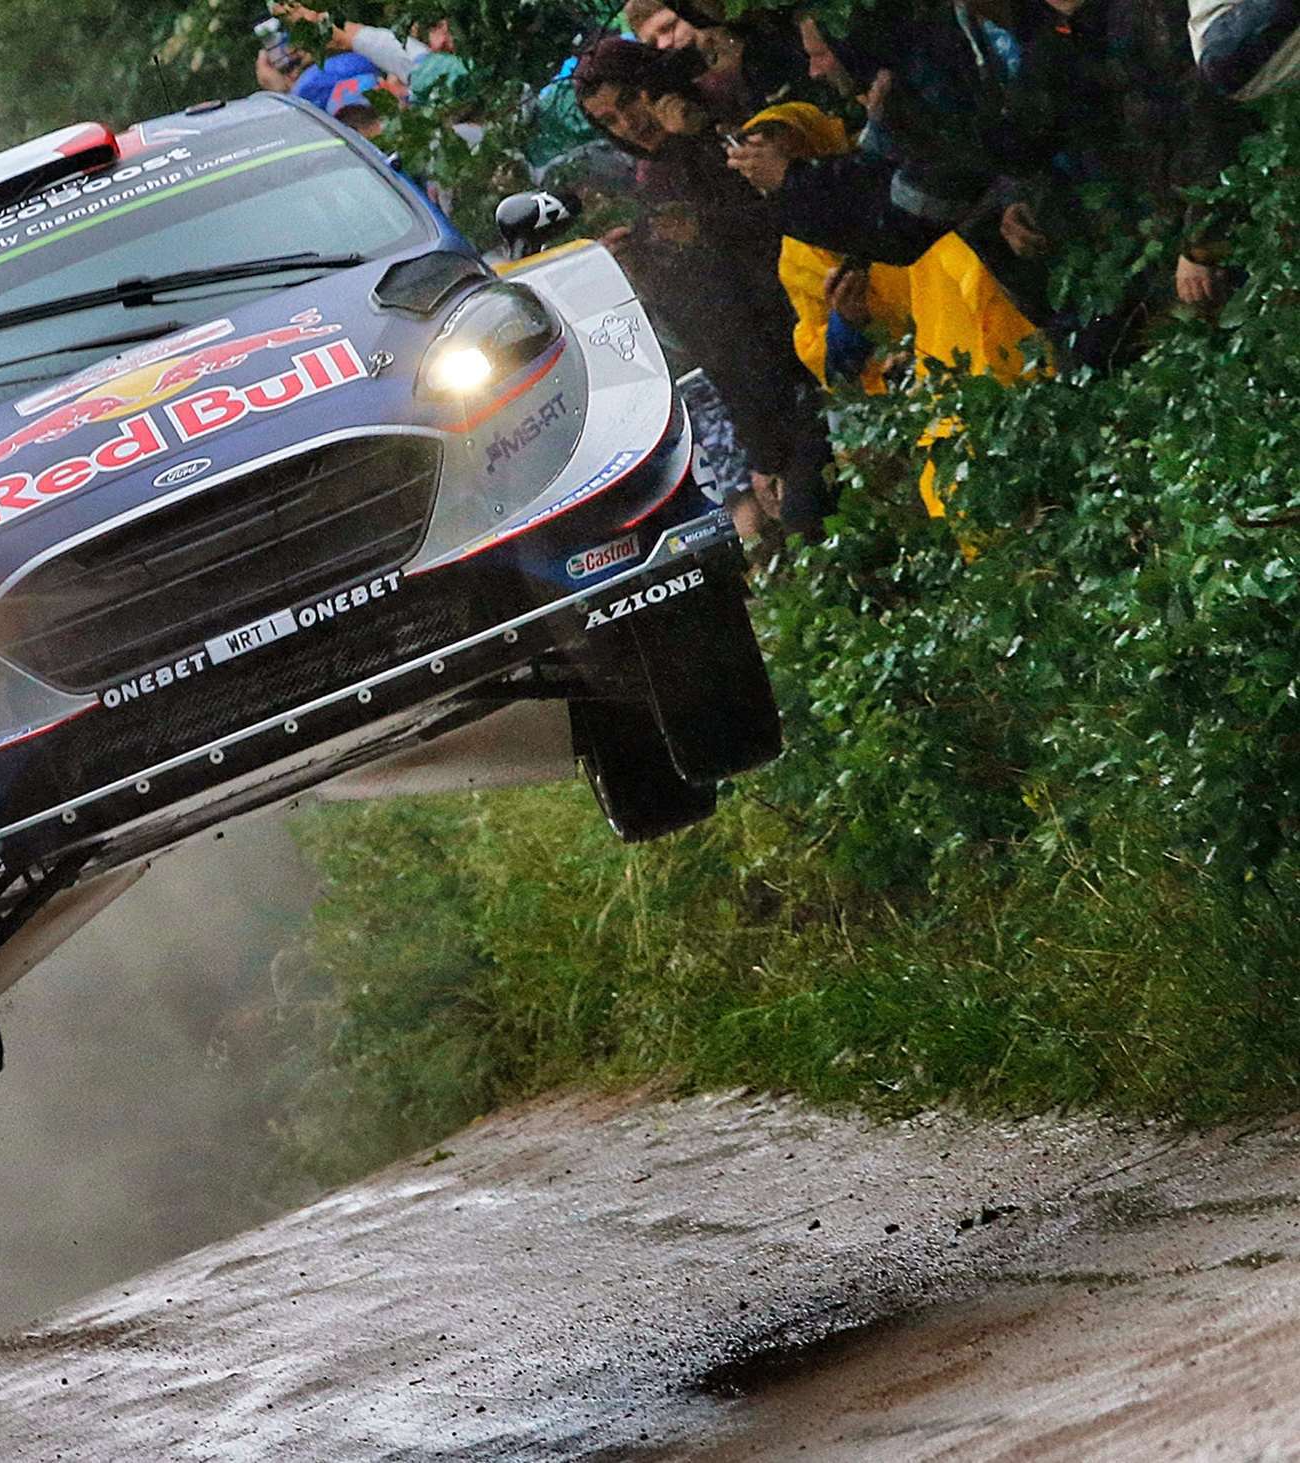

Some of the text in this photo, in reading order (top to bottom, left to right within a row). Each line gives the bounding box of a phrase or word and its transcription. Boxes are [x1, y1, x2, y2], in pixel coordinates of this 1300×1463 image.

[26, 171, 182, 237] Championship
[164, 337, 371, 445] Bull
[586, 539, 637, 572] Castrol
[299, 570, 401, 628] ONEBET
[585, 568, 705, 631] AZIONE
[226, 625, 264, 654] WRT
[103, 651, 206, 709] ONEBET
